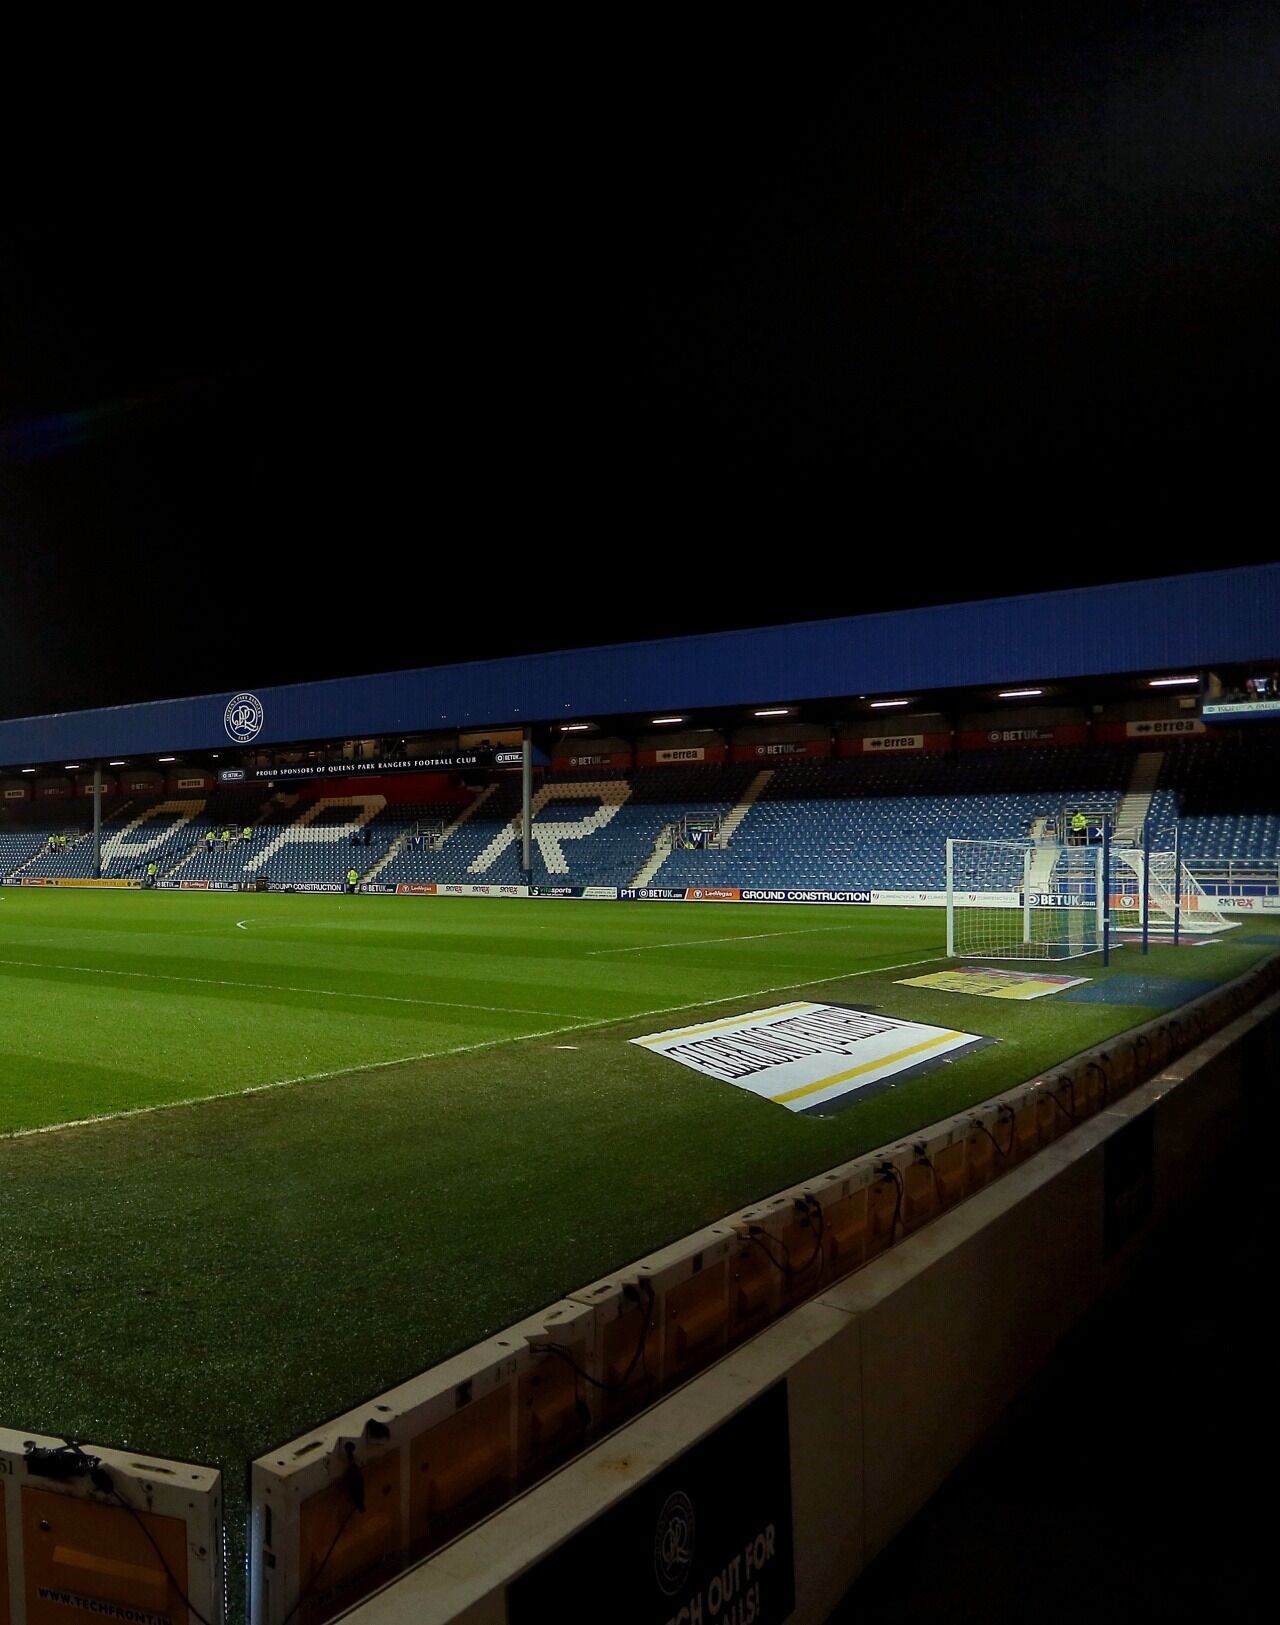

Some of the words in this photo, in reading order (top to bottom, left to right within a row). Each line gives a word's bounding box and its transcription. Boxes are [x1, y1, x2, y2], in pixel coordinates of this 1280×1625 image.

[280, 767, 314, 775] SPONSORS
[328, 764, 355, 773] QUEENS
[378, 761, 412, 769] RANGERS
[414, 758, 453, 767] FOOTBALL
[456, 756, 477, 764] CLUB
[692, 833, 702, 841] W
[1095, 828, 1104, 837] X
[415, 837, 421, 845] V
[293, 883, 341, 891] CONSTRUCTION
[620, 889, 636, 898] P11
[742, 890, 785, 900] GROUND
[787, 891, 870, 902] CONSTRUCTION
[708, 1554, 742, 1617] OUT
[744, 1523, 776, 1582] FOR
